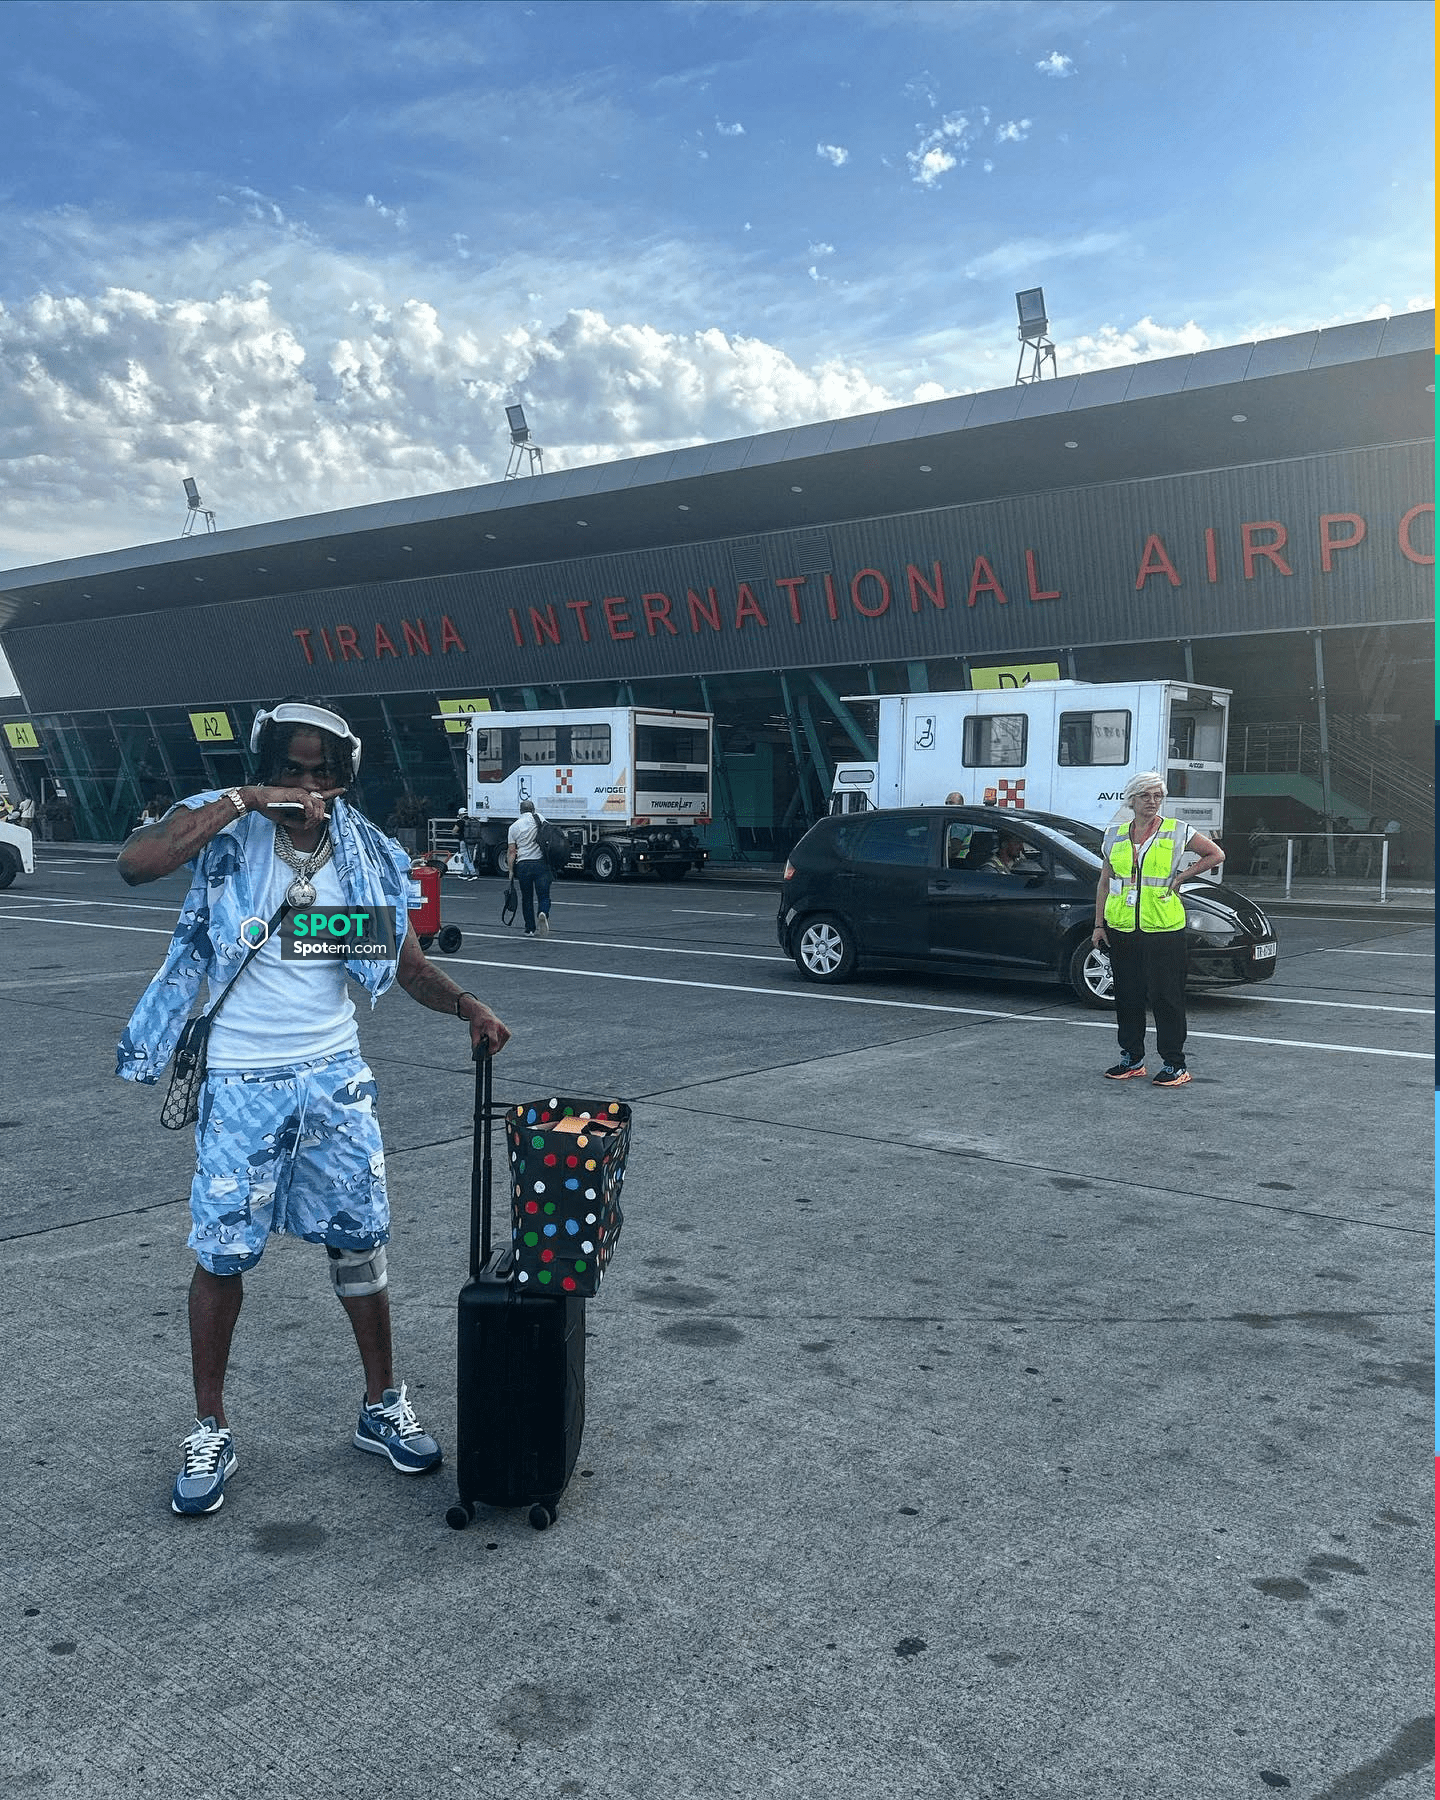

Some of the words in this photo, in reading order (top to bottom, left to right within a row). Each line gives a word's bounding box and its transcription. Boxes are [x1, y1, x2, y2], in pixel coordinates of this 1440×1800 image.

[293, 614, 467, 665] TIRANA
[508, 549, 1062, 648] INTERNATIONAL
[1135, 502, 1435, 591] AIRPO
[15, 726, 30, 745] A1
[203, 716, 222, 738] A2
[700, 801, 706, 812] 3
